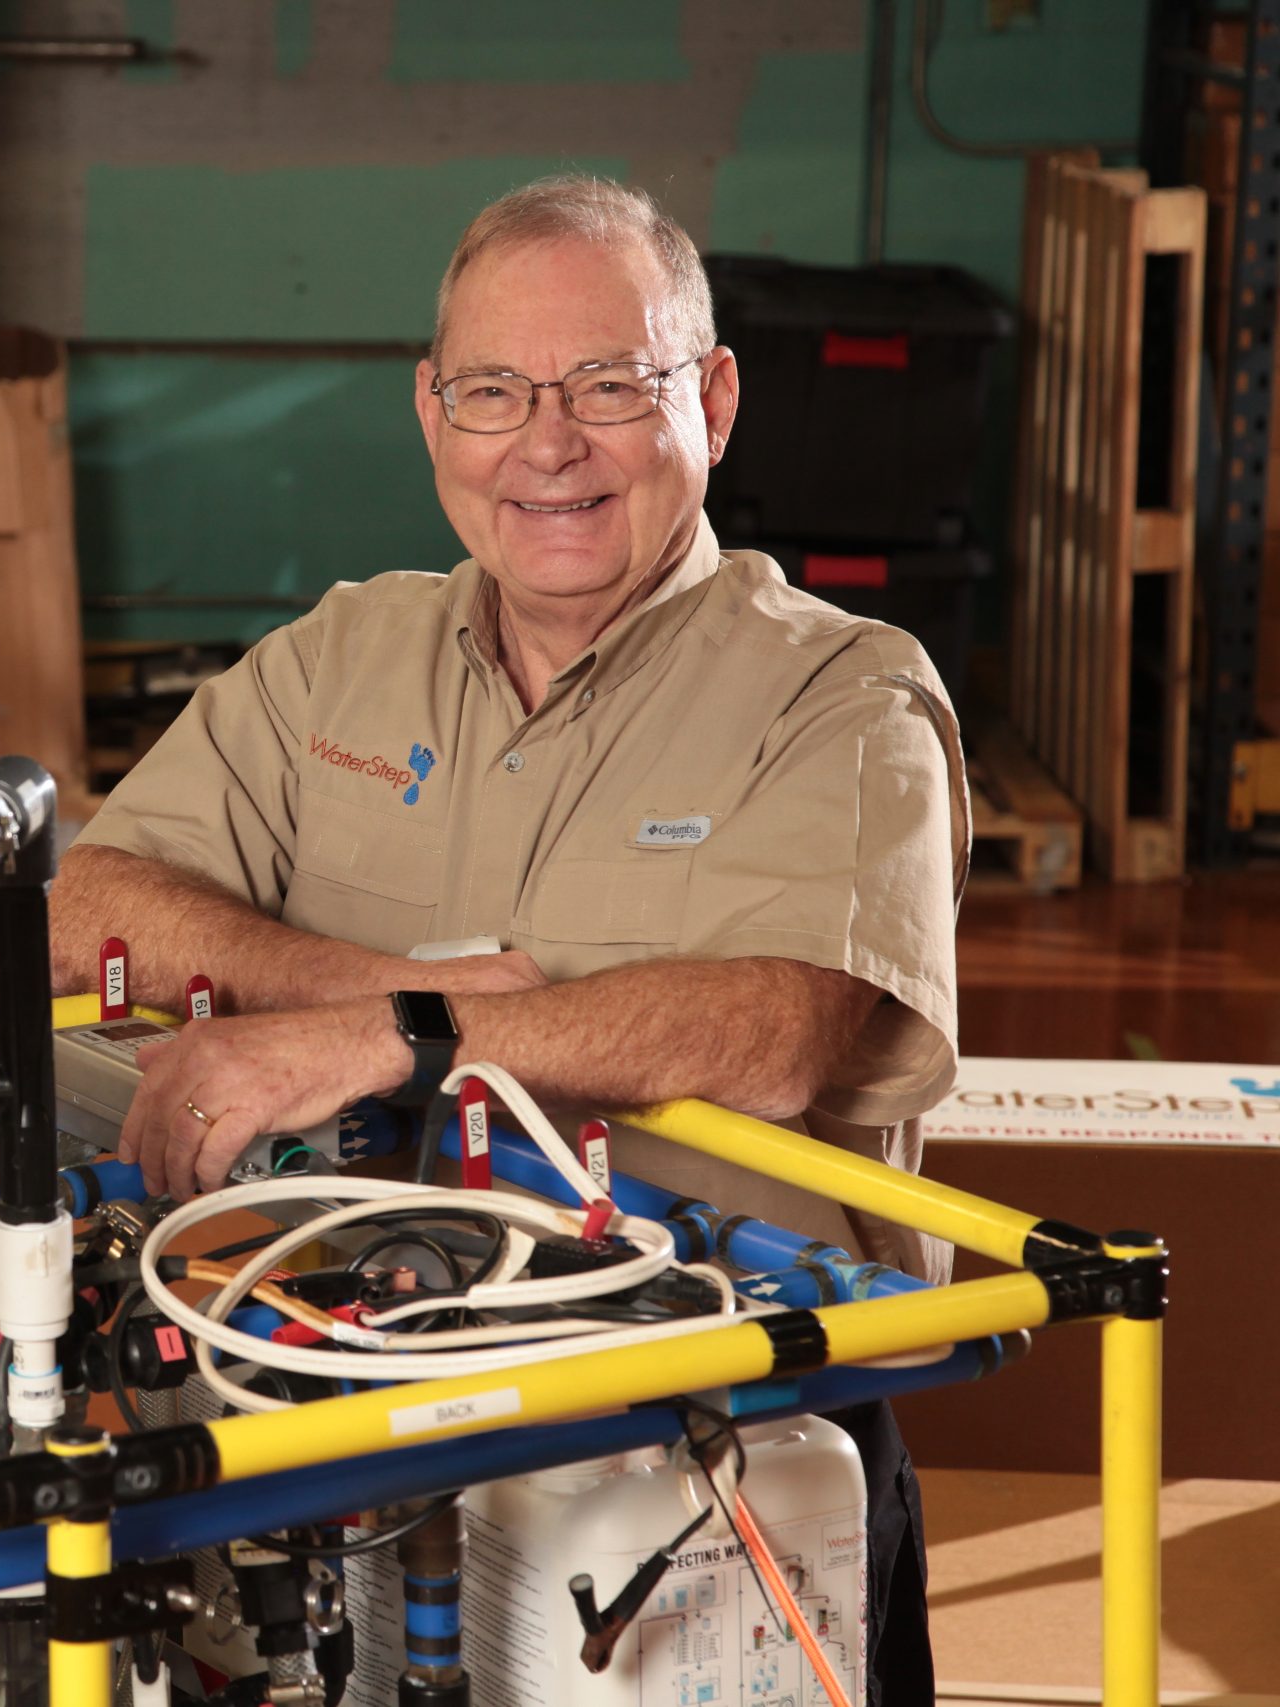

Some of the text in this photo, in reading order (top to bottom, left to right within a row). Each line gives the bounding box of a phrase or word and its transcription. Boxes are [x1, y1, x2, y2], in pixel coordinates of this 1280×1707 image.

[310, 732, 411, 789] WaterStep
[659, 823, 702, 835] Columbia
[110, 966, 122, 996] V18
[195, 999, 208, 1017] 19
[950, 1085, 1280, 1119] aterStep
[470, 1111, 484, 1145] V20
[590, 1151, 605, 1182] V21
[435, 1402, 477, 1422] BACK
